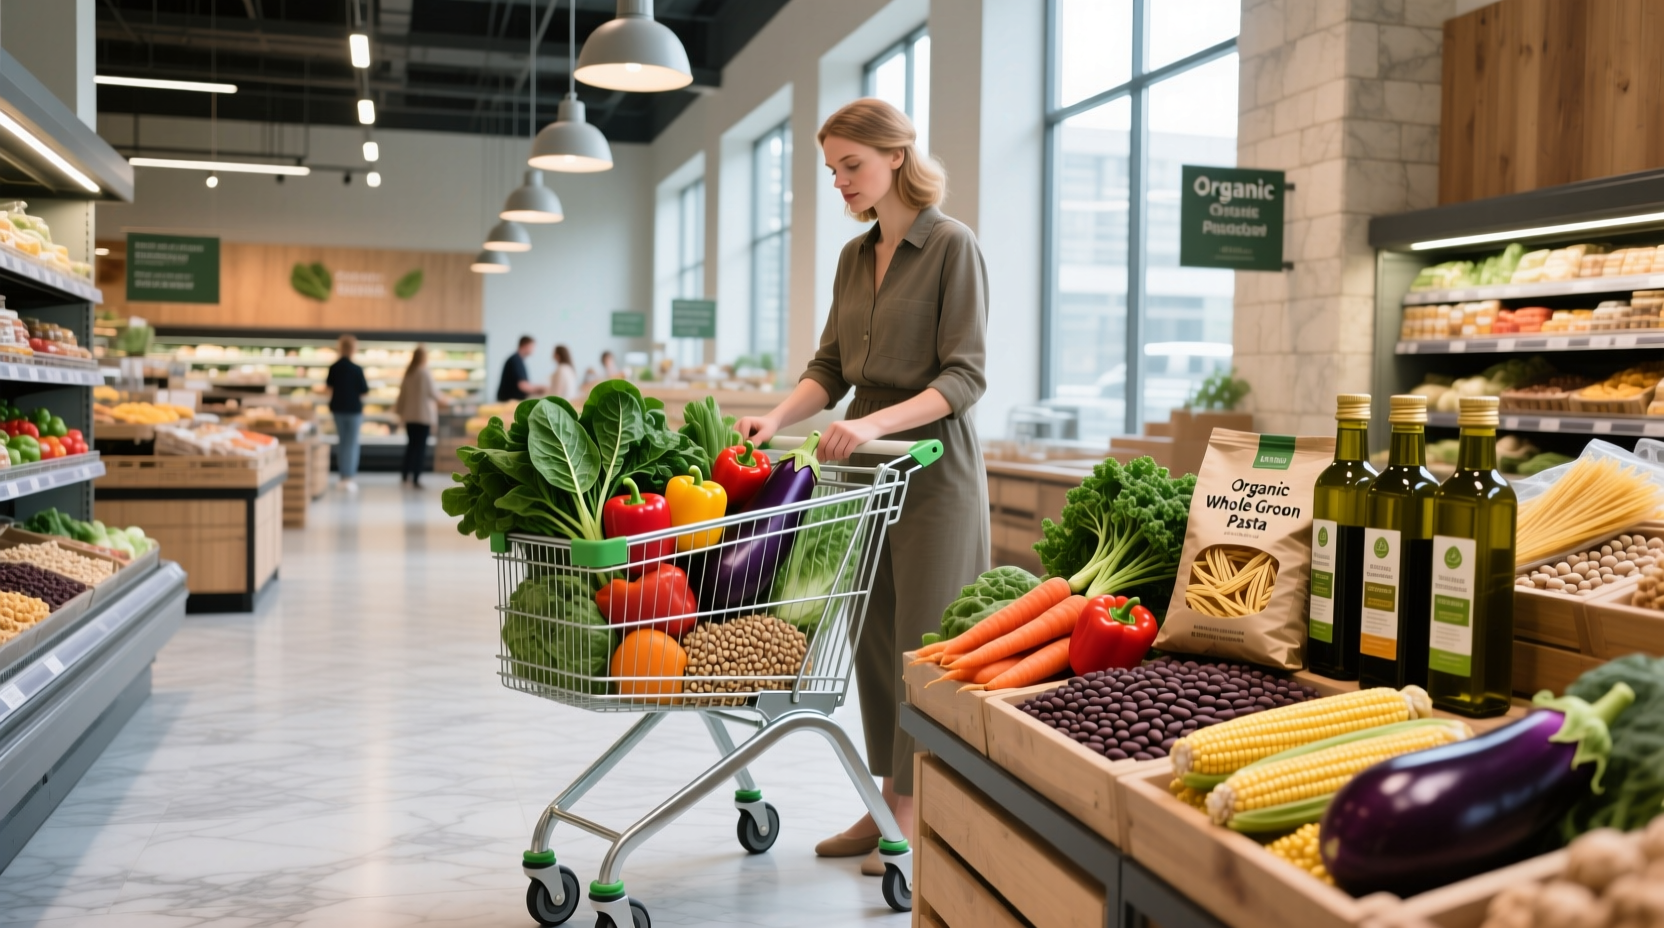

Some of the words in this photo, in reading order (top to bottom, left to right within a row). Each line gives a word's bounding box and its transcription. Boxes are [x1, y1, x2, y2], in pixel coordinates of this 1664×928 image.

[1193, 175, 1275, 204] Organic
[1231, 478, 1290, 498] Organic
[1206, 494, 1252, 512] Whole
[1226, 514, 1267, 531] Pasta
